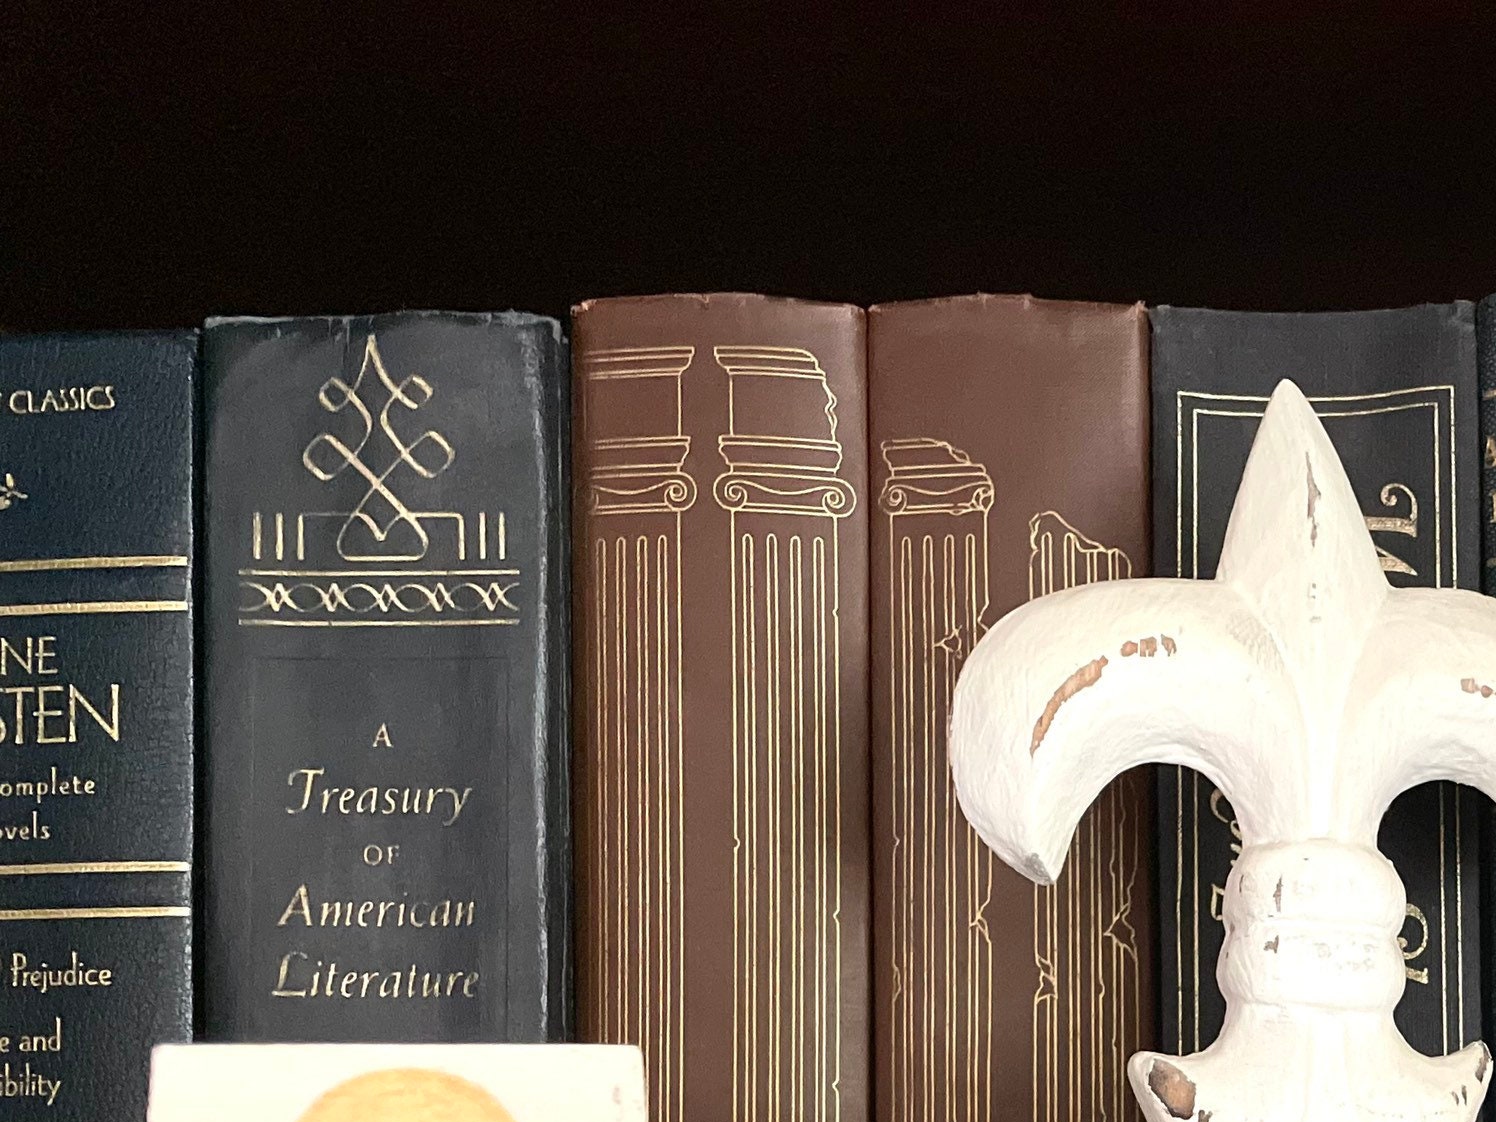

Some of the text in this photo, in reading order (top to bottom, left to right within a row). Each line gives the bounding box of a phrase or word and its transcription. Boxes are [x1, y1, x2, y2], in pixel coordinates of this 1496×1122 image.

[9, 385, 115, 413] CLASSICS
[372, 722, 394, 748] A
[285, 766, 473, 827] Treasury
[0, 810, 51, 840] vels
[362, 844, 400, 866] OF
[276, 883, 476, 929] American
[10, 950, 113, 994] Prejudice
[270, 950, 480, 998] Literature
[18, 1016, 62, 1052] and
